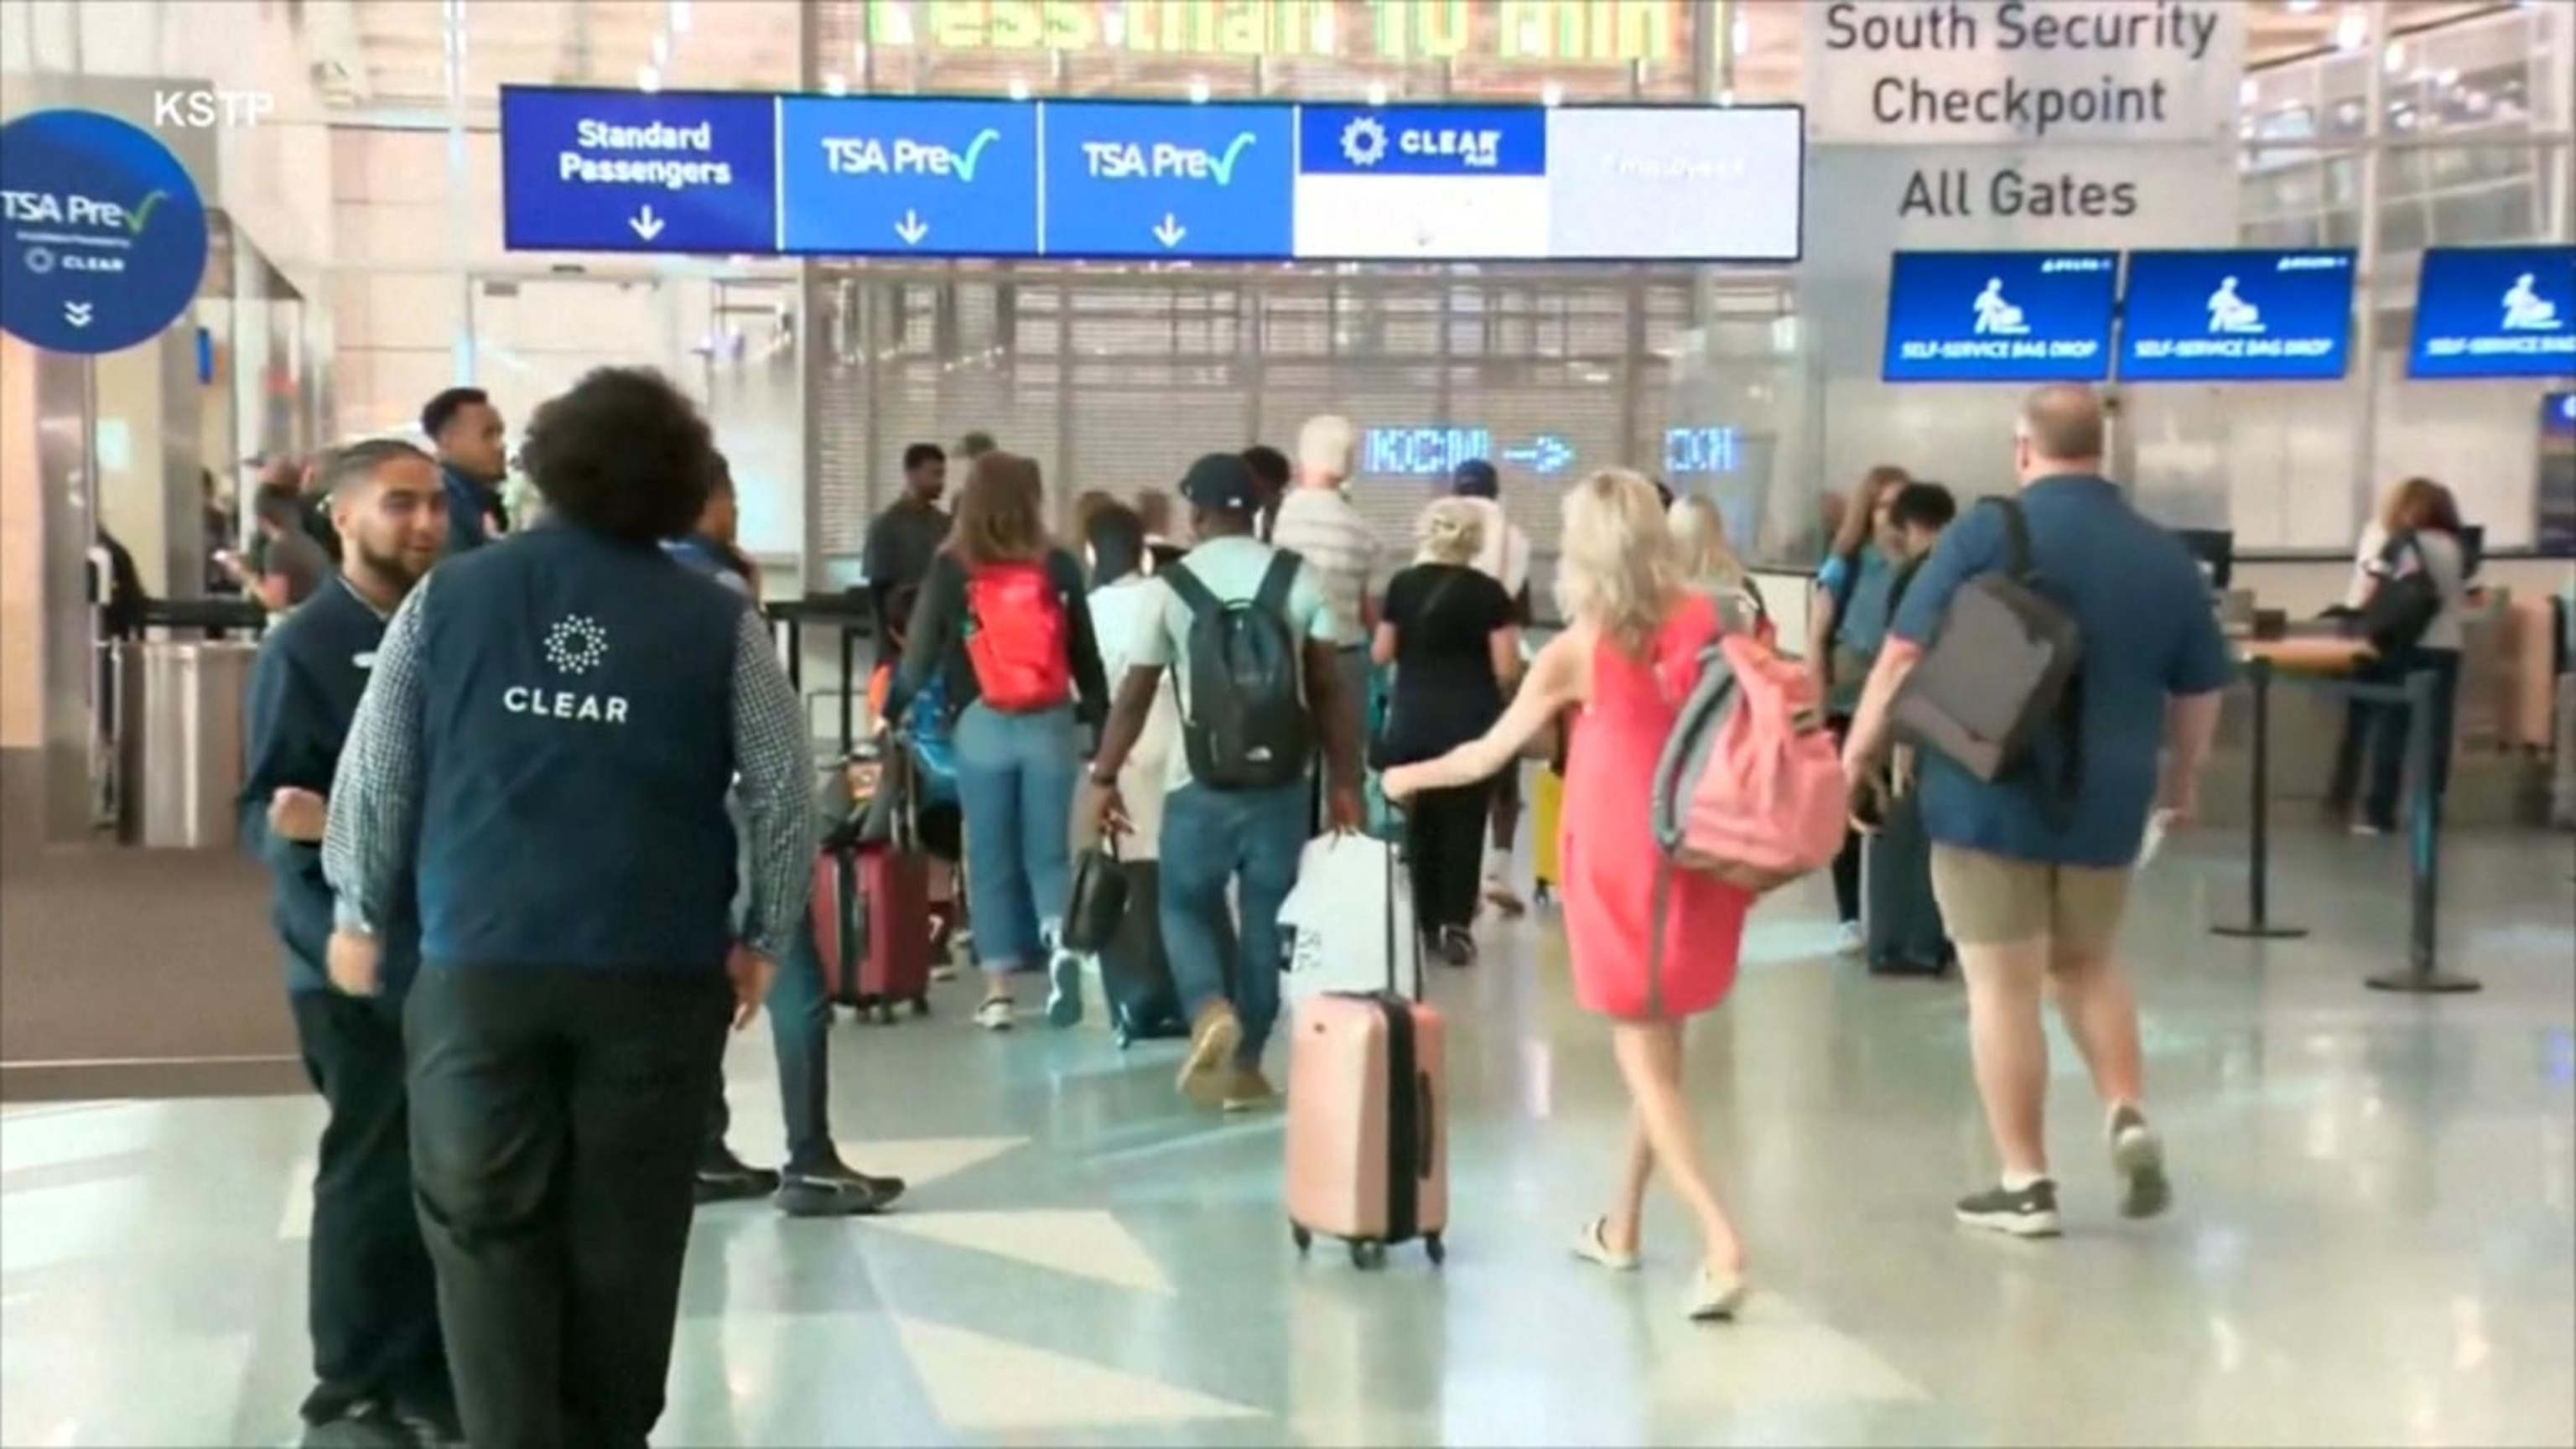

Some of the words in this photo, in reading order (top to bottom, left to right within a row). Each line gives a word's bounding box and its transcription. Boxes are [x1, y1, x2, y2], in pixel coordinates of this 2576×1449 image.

[1826, 3, 1976, 49] South
[1996, 1, 2217, 60] Security
[1872, 76, 2167, 136] Checkpoint
[577, 118, 711, 151] Standard
[1400, 128, 1498, 154] CLEAR
[560, 151, 731, 190] Passengers
[821, 138, 890, 174] TSA
[893, 138, 952, 175] Pre
[1082, 142, 1149, 178] TSA
[1153, 143, 1208, 179] Pre
[0, 190, 63, 224] TSA
[68, 195, 123, 227] Pre
[1898, 170, 1970, 217] All
[1990, 169, 2137, 217] Gates
[62, 255, 124, 272] CLEAR
[503, 686, 628, 724] CLEAR
